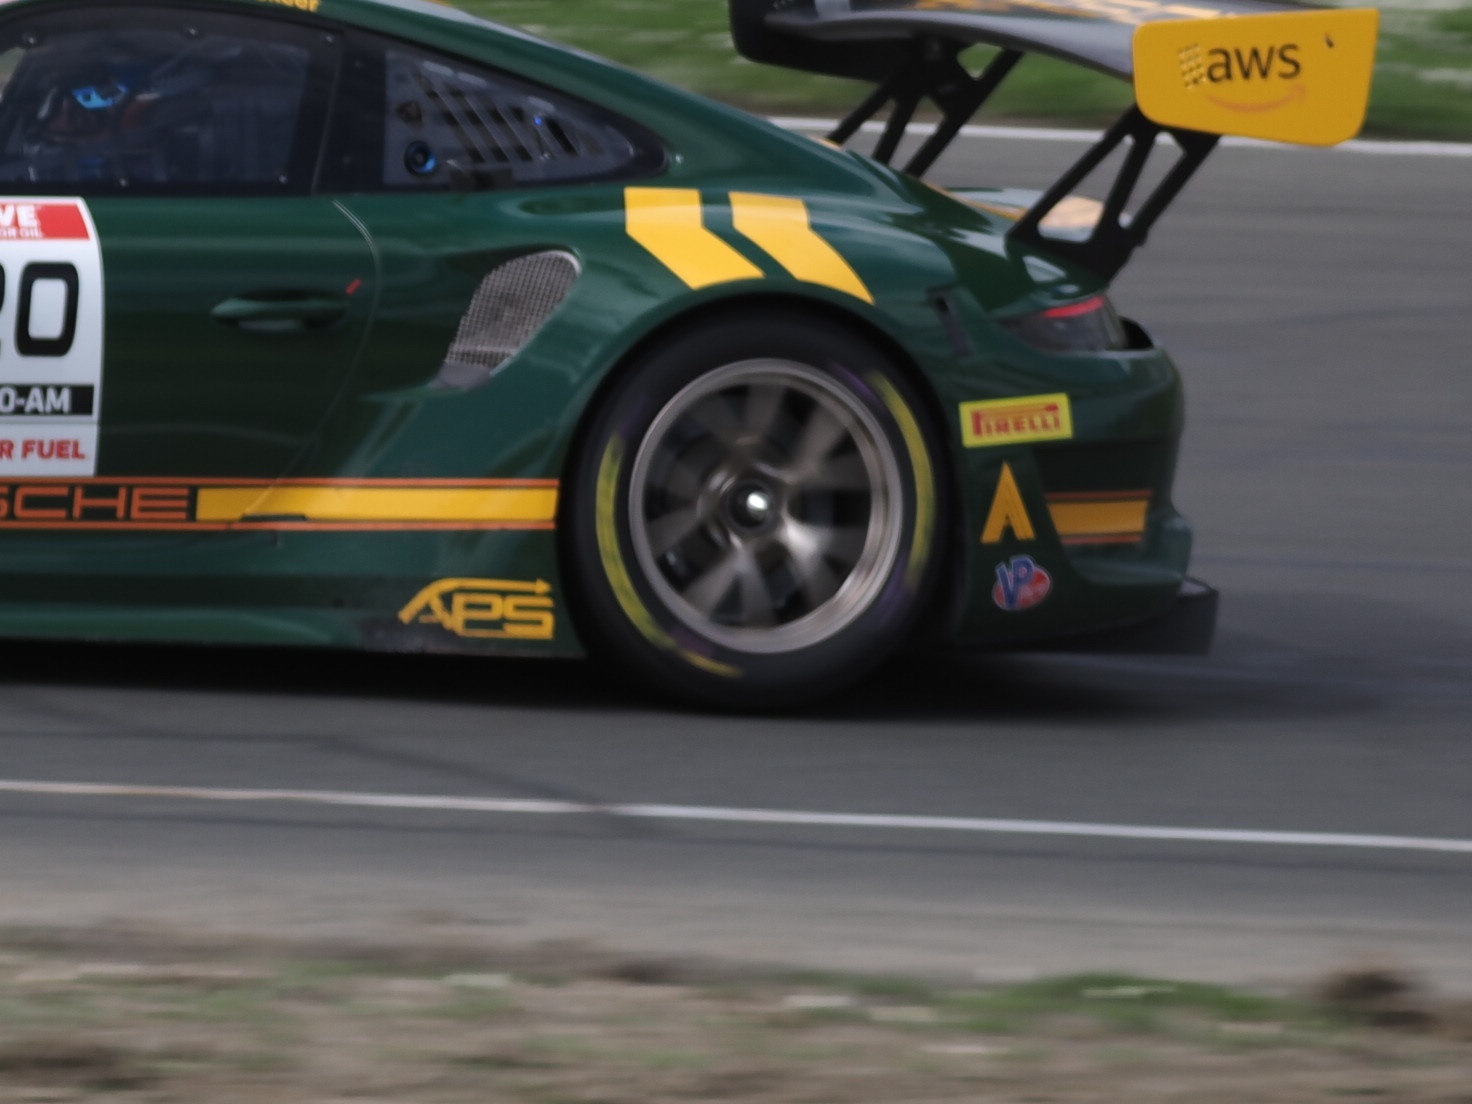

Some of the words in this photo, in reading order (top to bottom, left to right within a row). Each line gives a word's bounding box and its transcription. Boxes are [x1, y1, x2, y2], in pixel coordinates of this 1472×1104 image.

[1206, 43, 1302, 83] aws
[971, 402, 1061, 437] PIRELLI
[21, 439, 86, 460] FUEL
